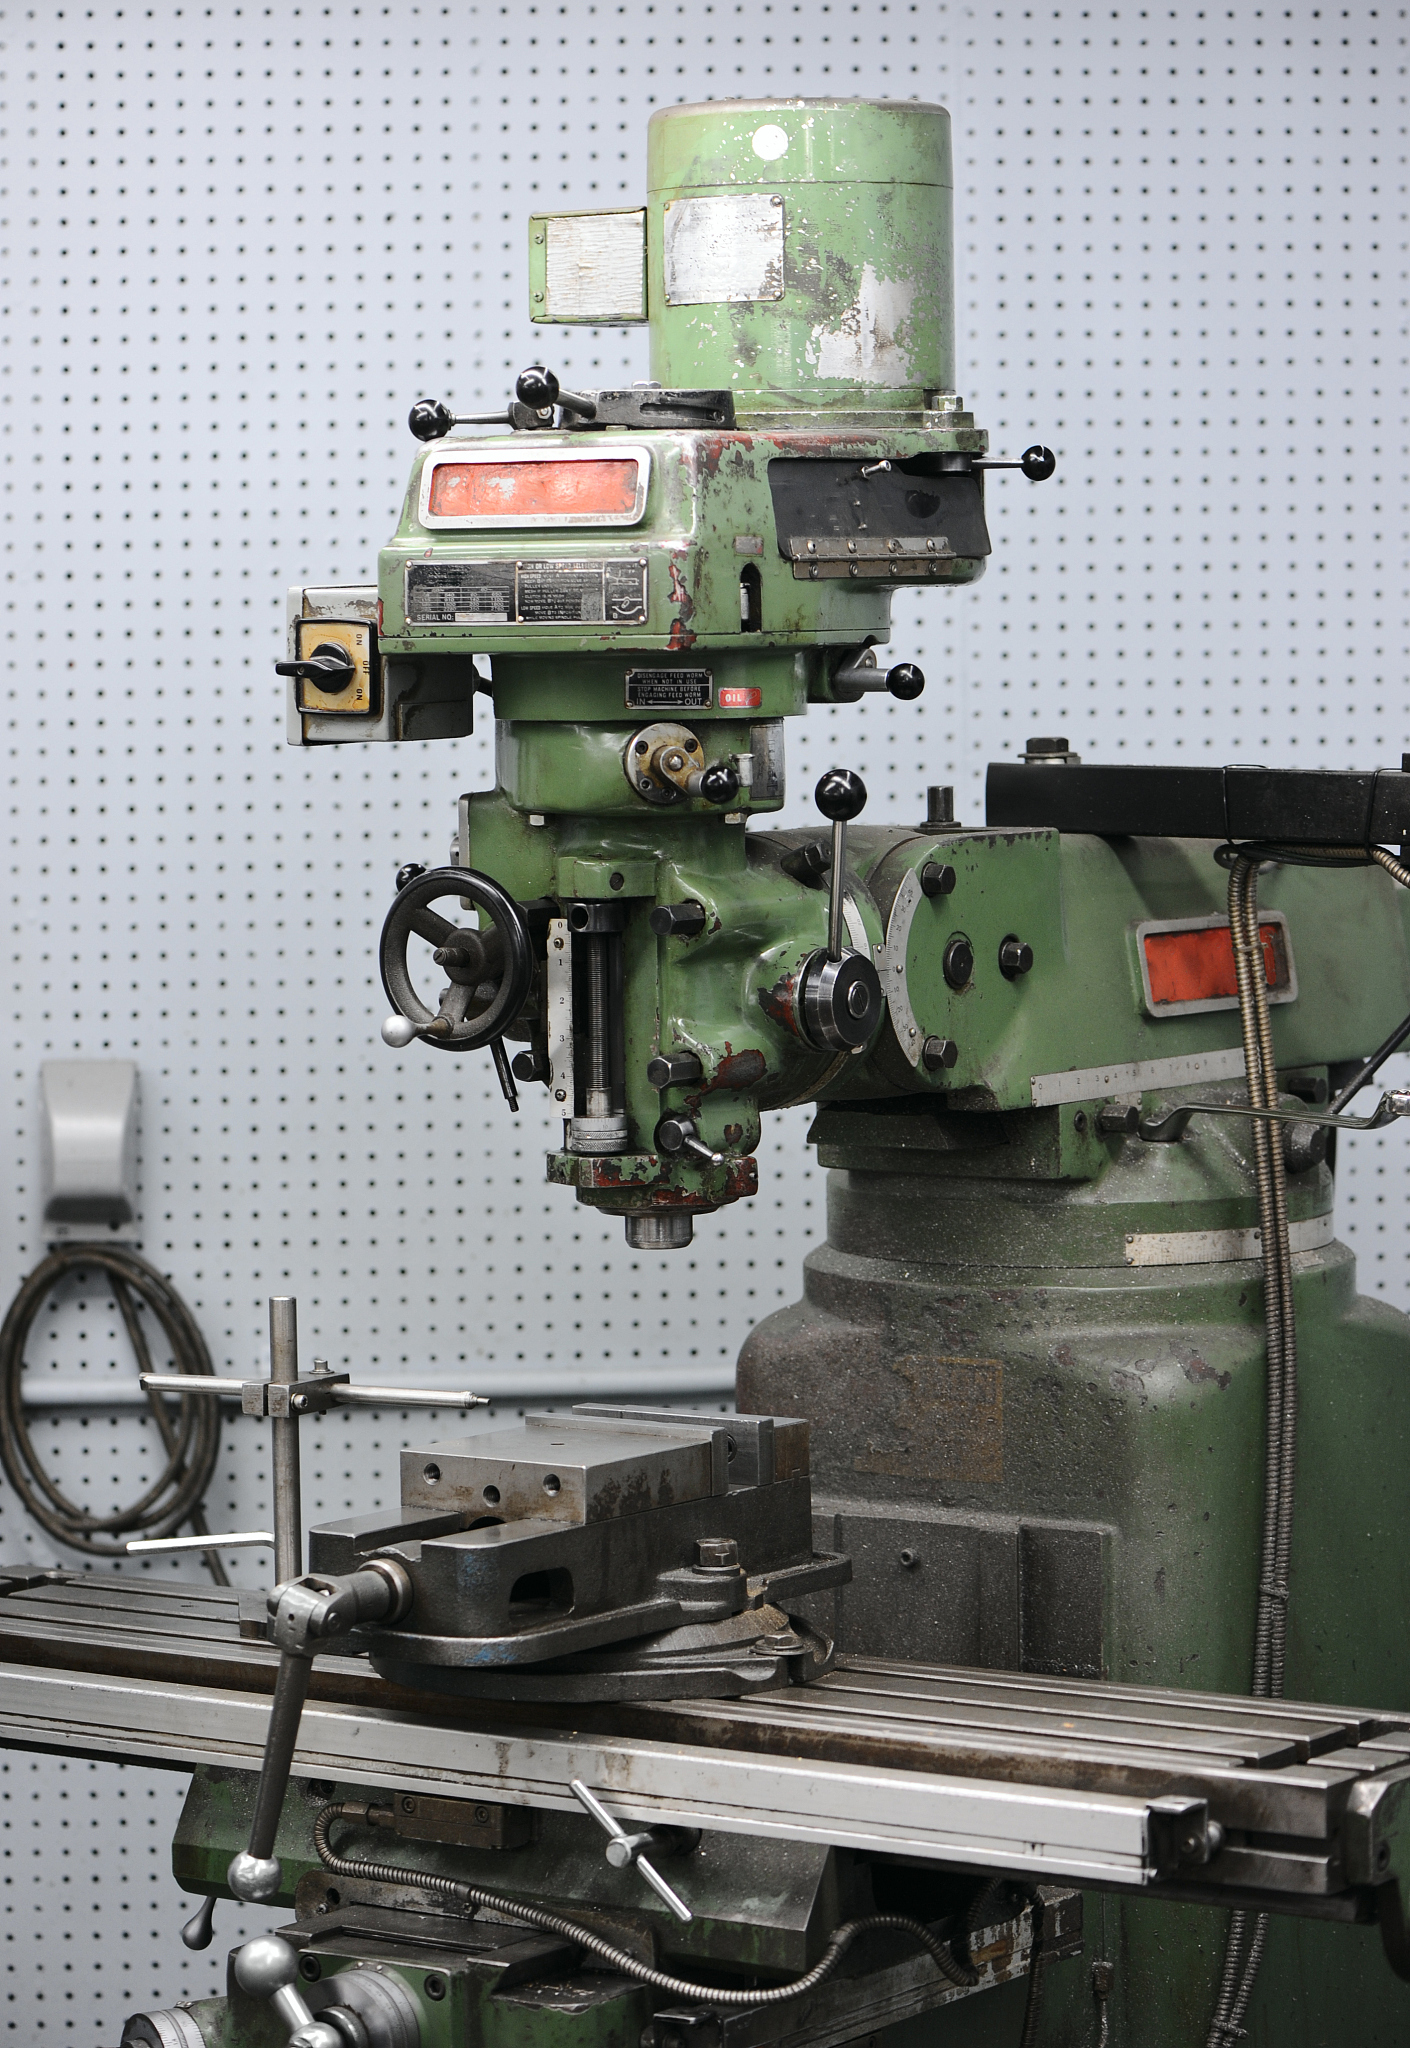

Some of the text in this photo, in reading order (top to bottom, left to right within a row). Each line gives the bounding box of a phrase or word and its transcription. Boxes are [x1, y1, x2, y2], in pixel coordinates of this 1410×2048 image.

[356, 634, 362, 645] ON
[356, 688, 362, 700] ON
[725, 694, 742, 702] OIL
